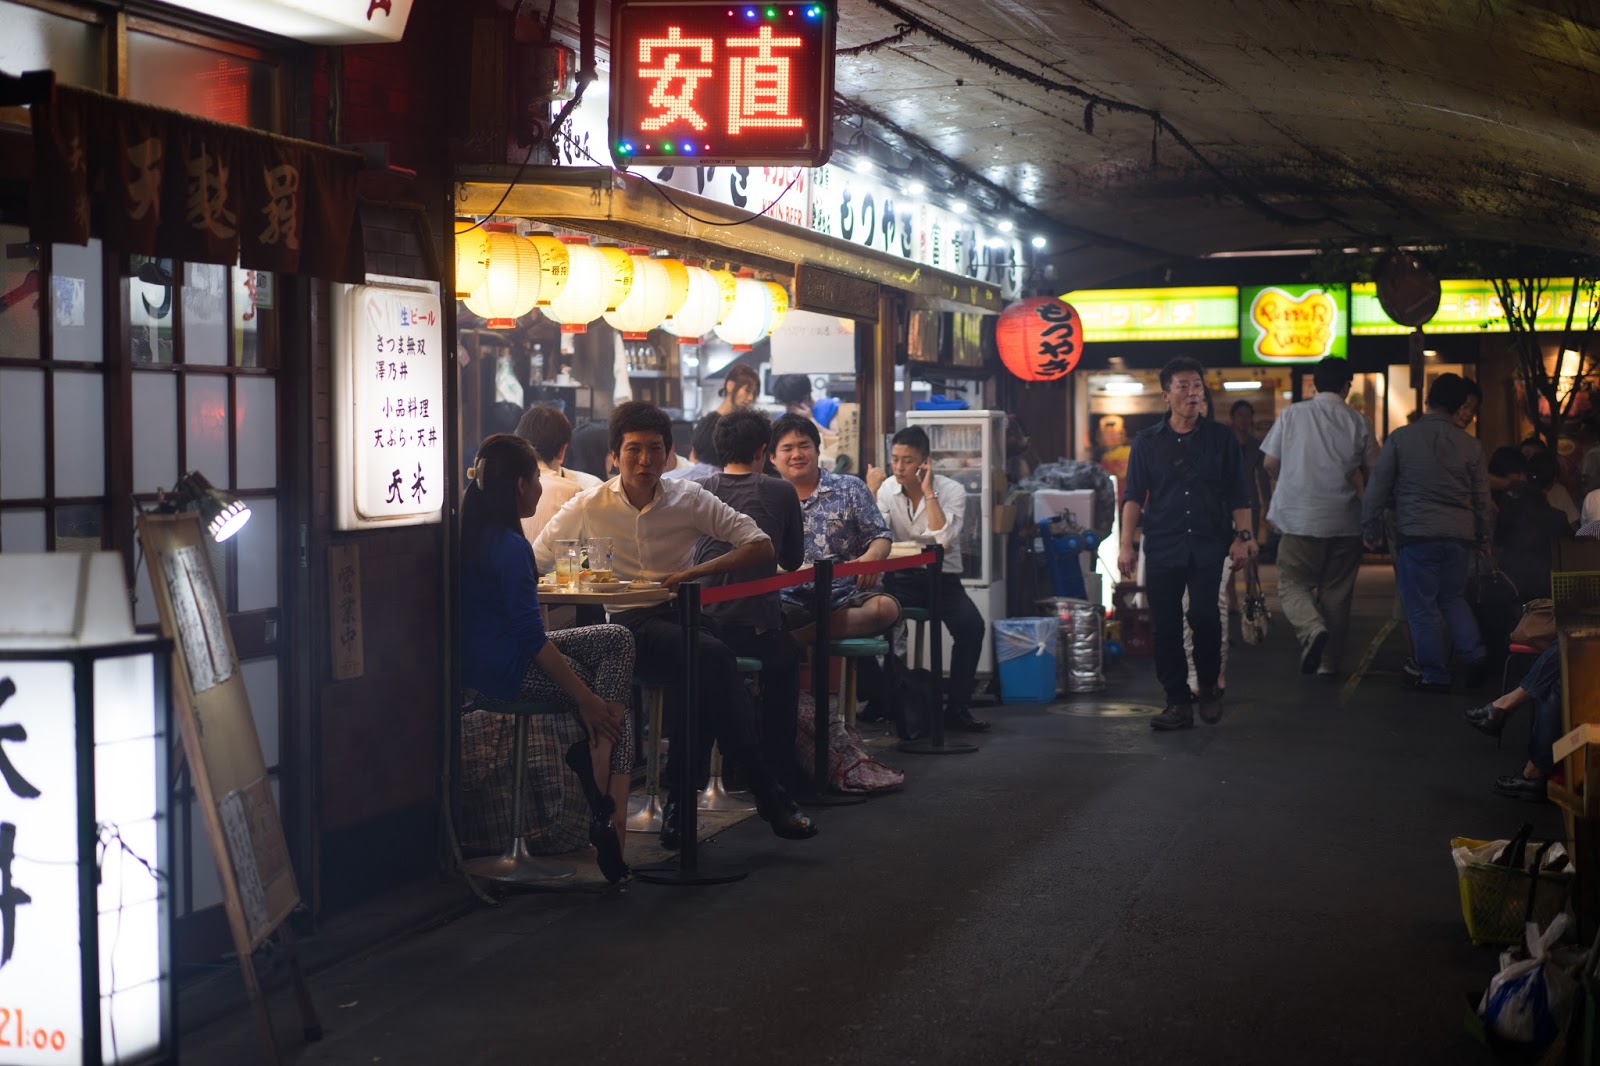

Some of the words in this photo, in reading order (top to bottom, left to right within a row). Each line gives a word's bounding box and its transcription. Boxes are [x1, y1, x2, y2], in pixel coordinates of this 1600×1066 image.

[638, 26, 804, 135] 安直
[786, 206, 803, 226] BEER
[400, 306, 435, 327] 生ビール
[376, 335, 426, 356] さつま無双
[1035, 303, 1074, 376] もつやき
[375, 360, 409, 381] 澤乃井
[381, 396, 429, 419] 小品料理
[385, 461, 427, 504] 天米
